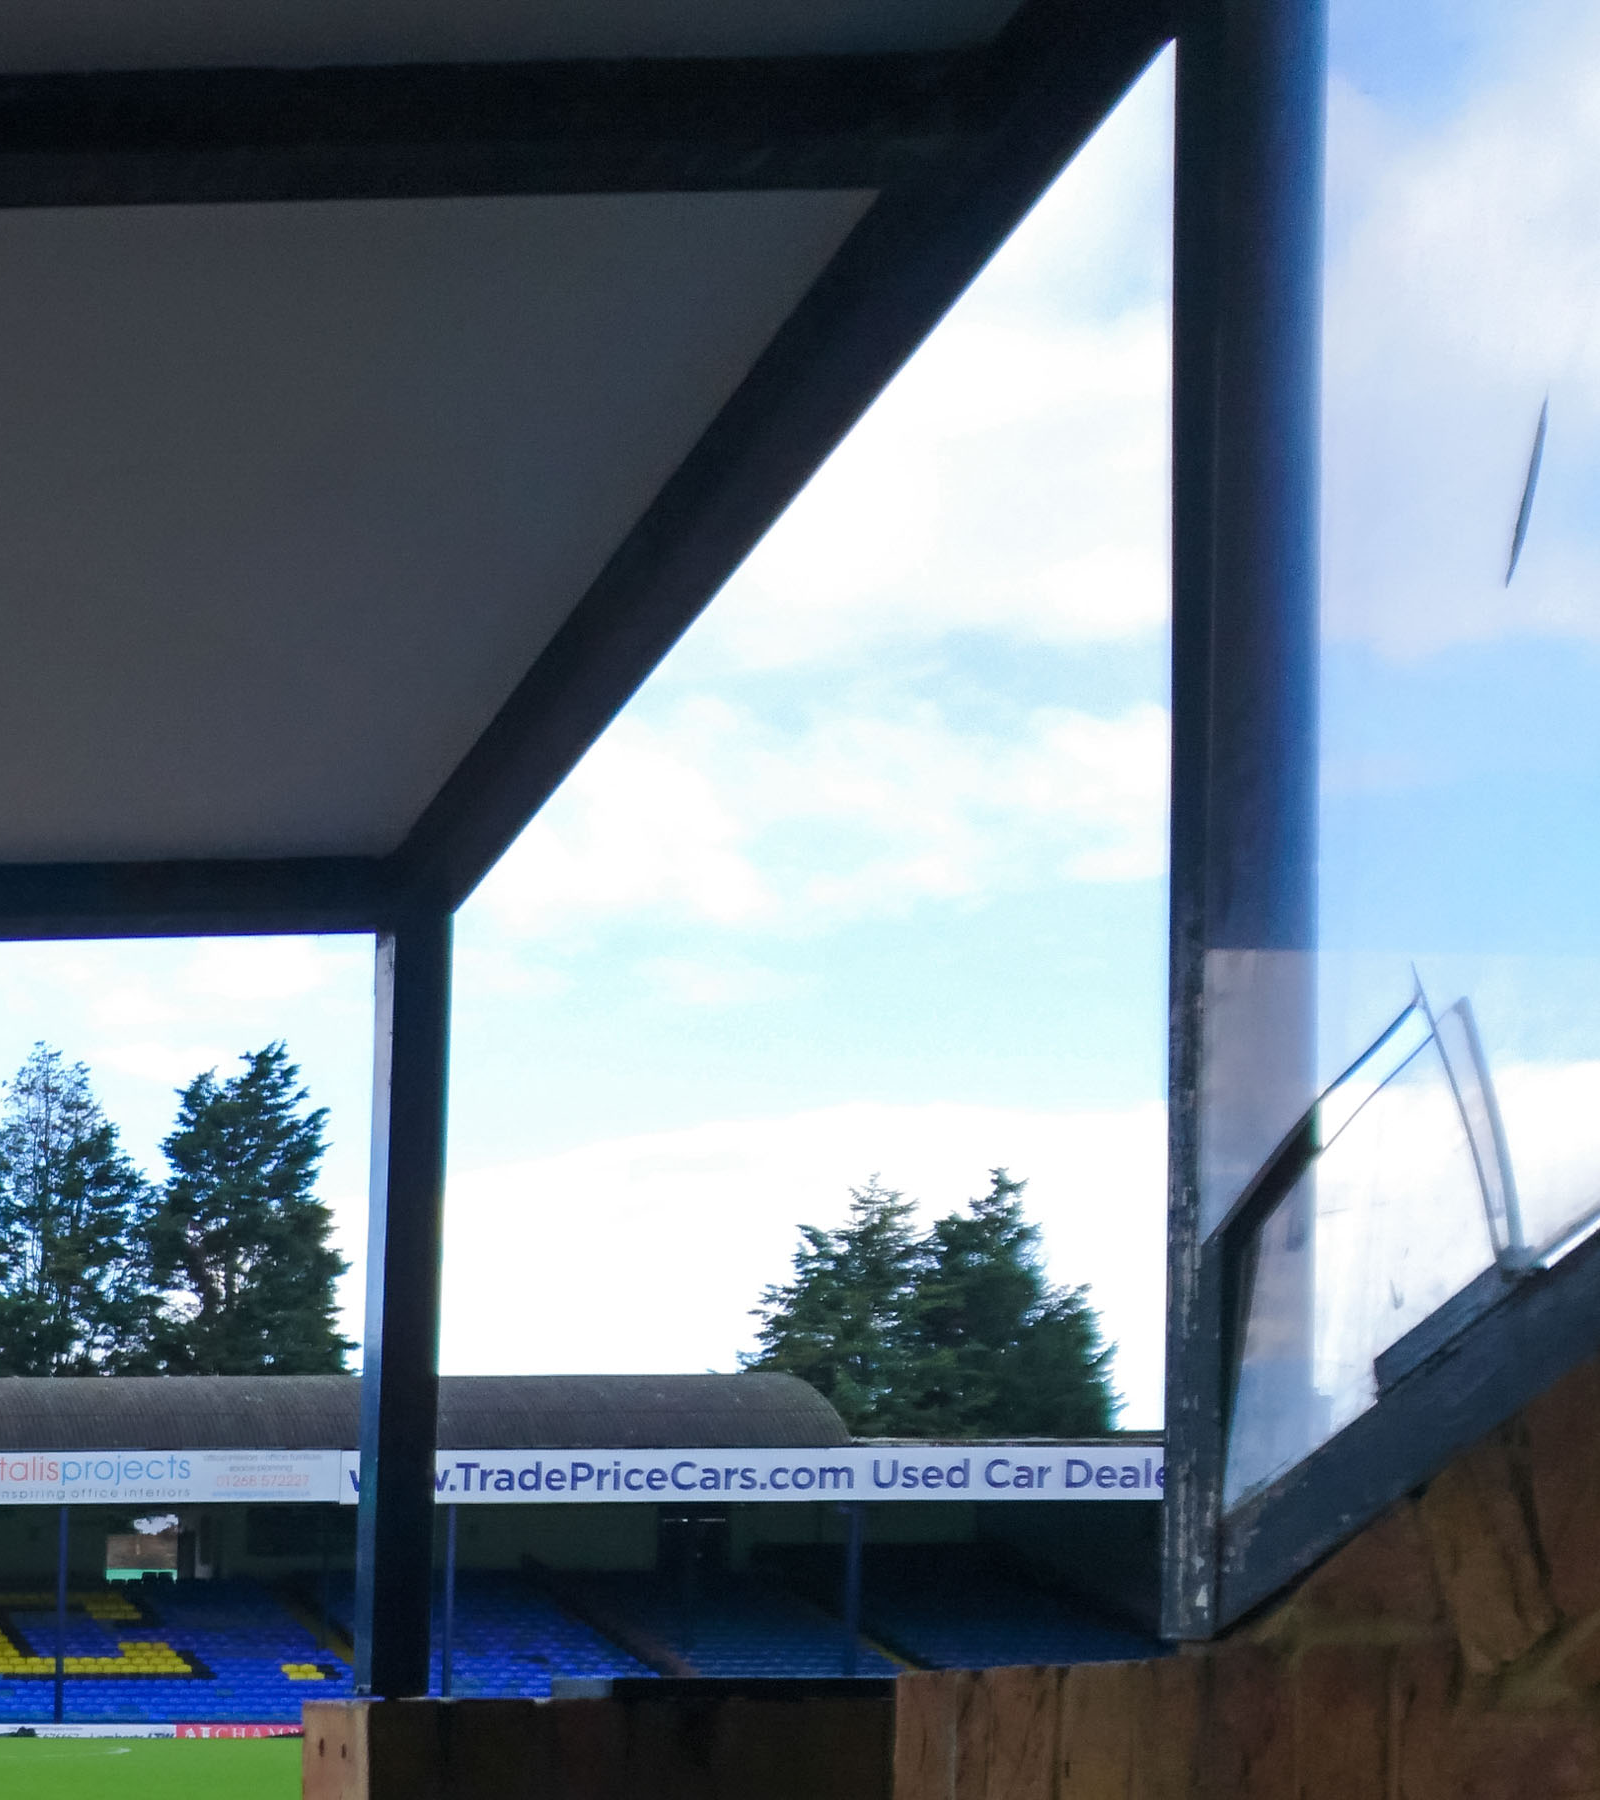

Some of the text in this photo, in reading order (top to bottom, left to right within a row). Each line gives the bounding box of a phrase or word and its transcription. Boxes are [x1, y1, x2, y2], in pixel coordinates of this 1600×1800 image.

[872, 1458, 971, 1490] Used
[983, 1458, 1053, 1490] Car
[70, 1488, 119, 1498] office
[124, 1487, 192, 1498] interiors
